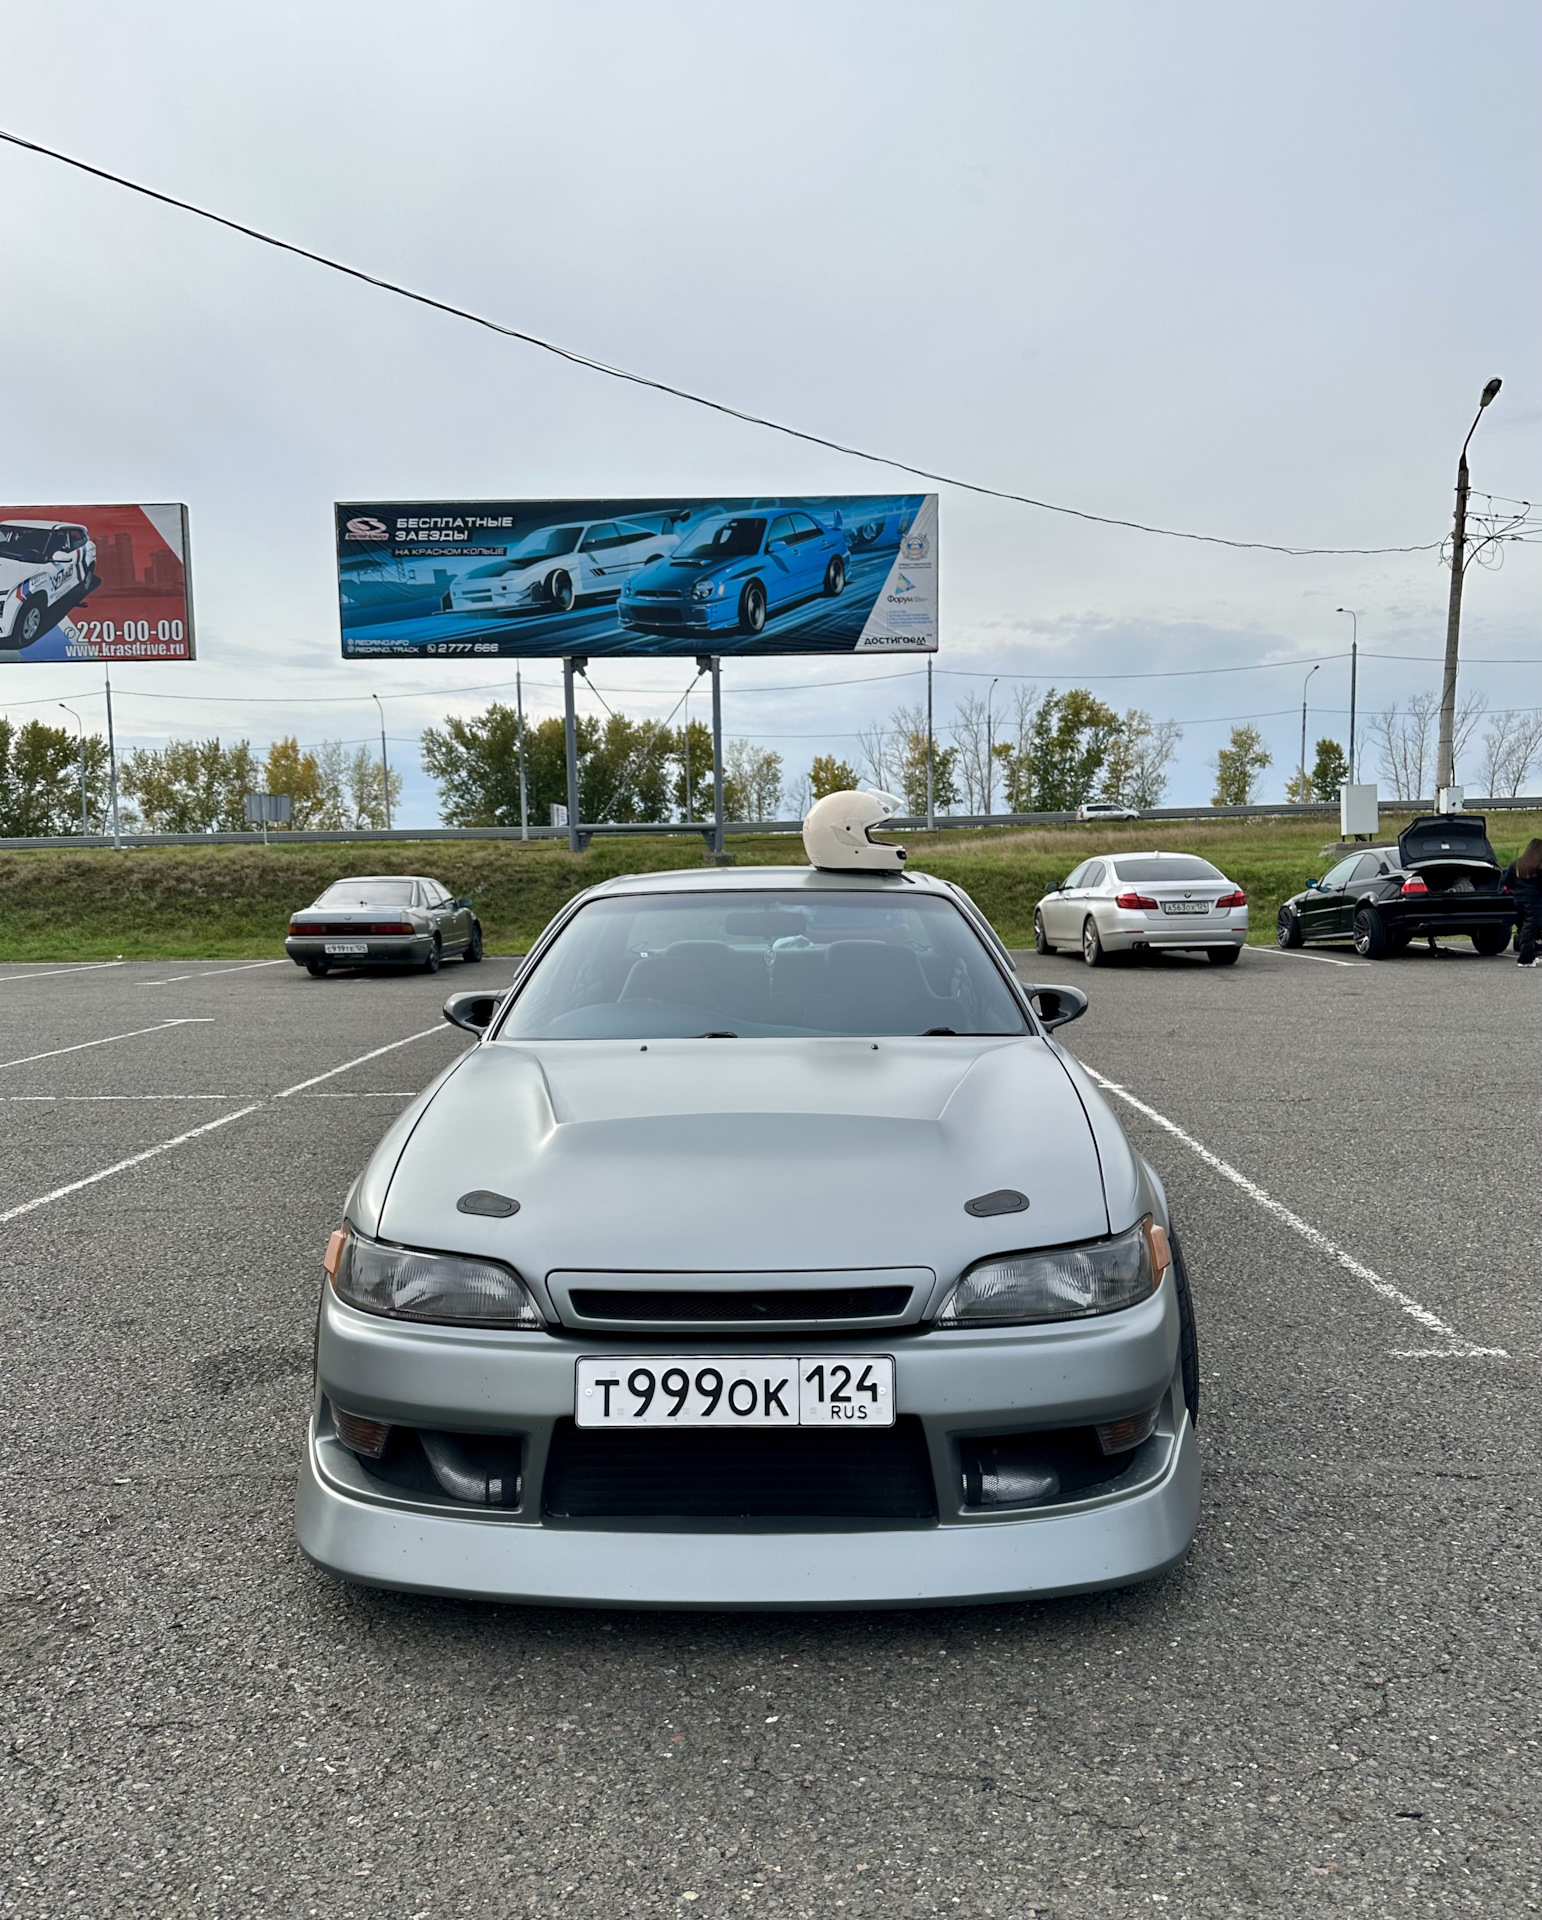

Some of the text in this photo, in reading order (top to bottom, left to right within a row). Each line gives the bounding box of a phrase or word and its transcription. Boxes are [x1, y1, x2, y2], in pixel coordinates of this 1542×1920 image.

[396, 517, 514, 529] БЕСПЛАТНЫЕ
[395, 530, 469, 541] ЗАЕЗДЫ
[395, 547, 506, 556] НА КРАСНОМ КОЛЬЦЕ
[887, 595, 914, 604] Форум
[77, 619, 184, 642] 220-00-00
[65, 642, 185, 657] www.krasdrive.ru
[473, 642, 499, 653] 666
[805, 1365, 878, 1403] 124
[831, 1405, 868, 1420] RUS
